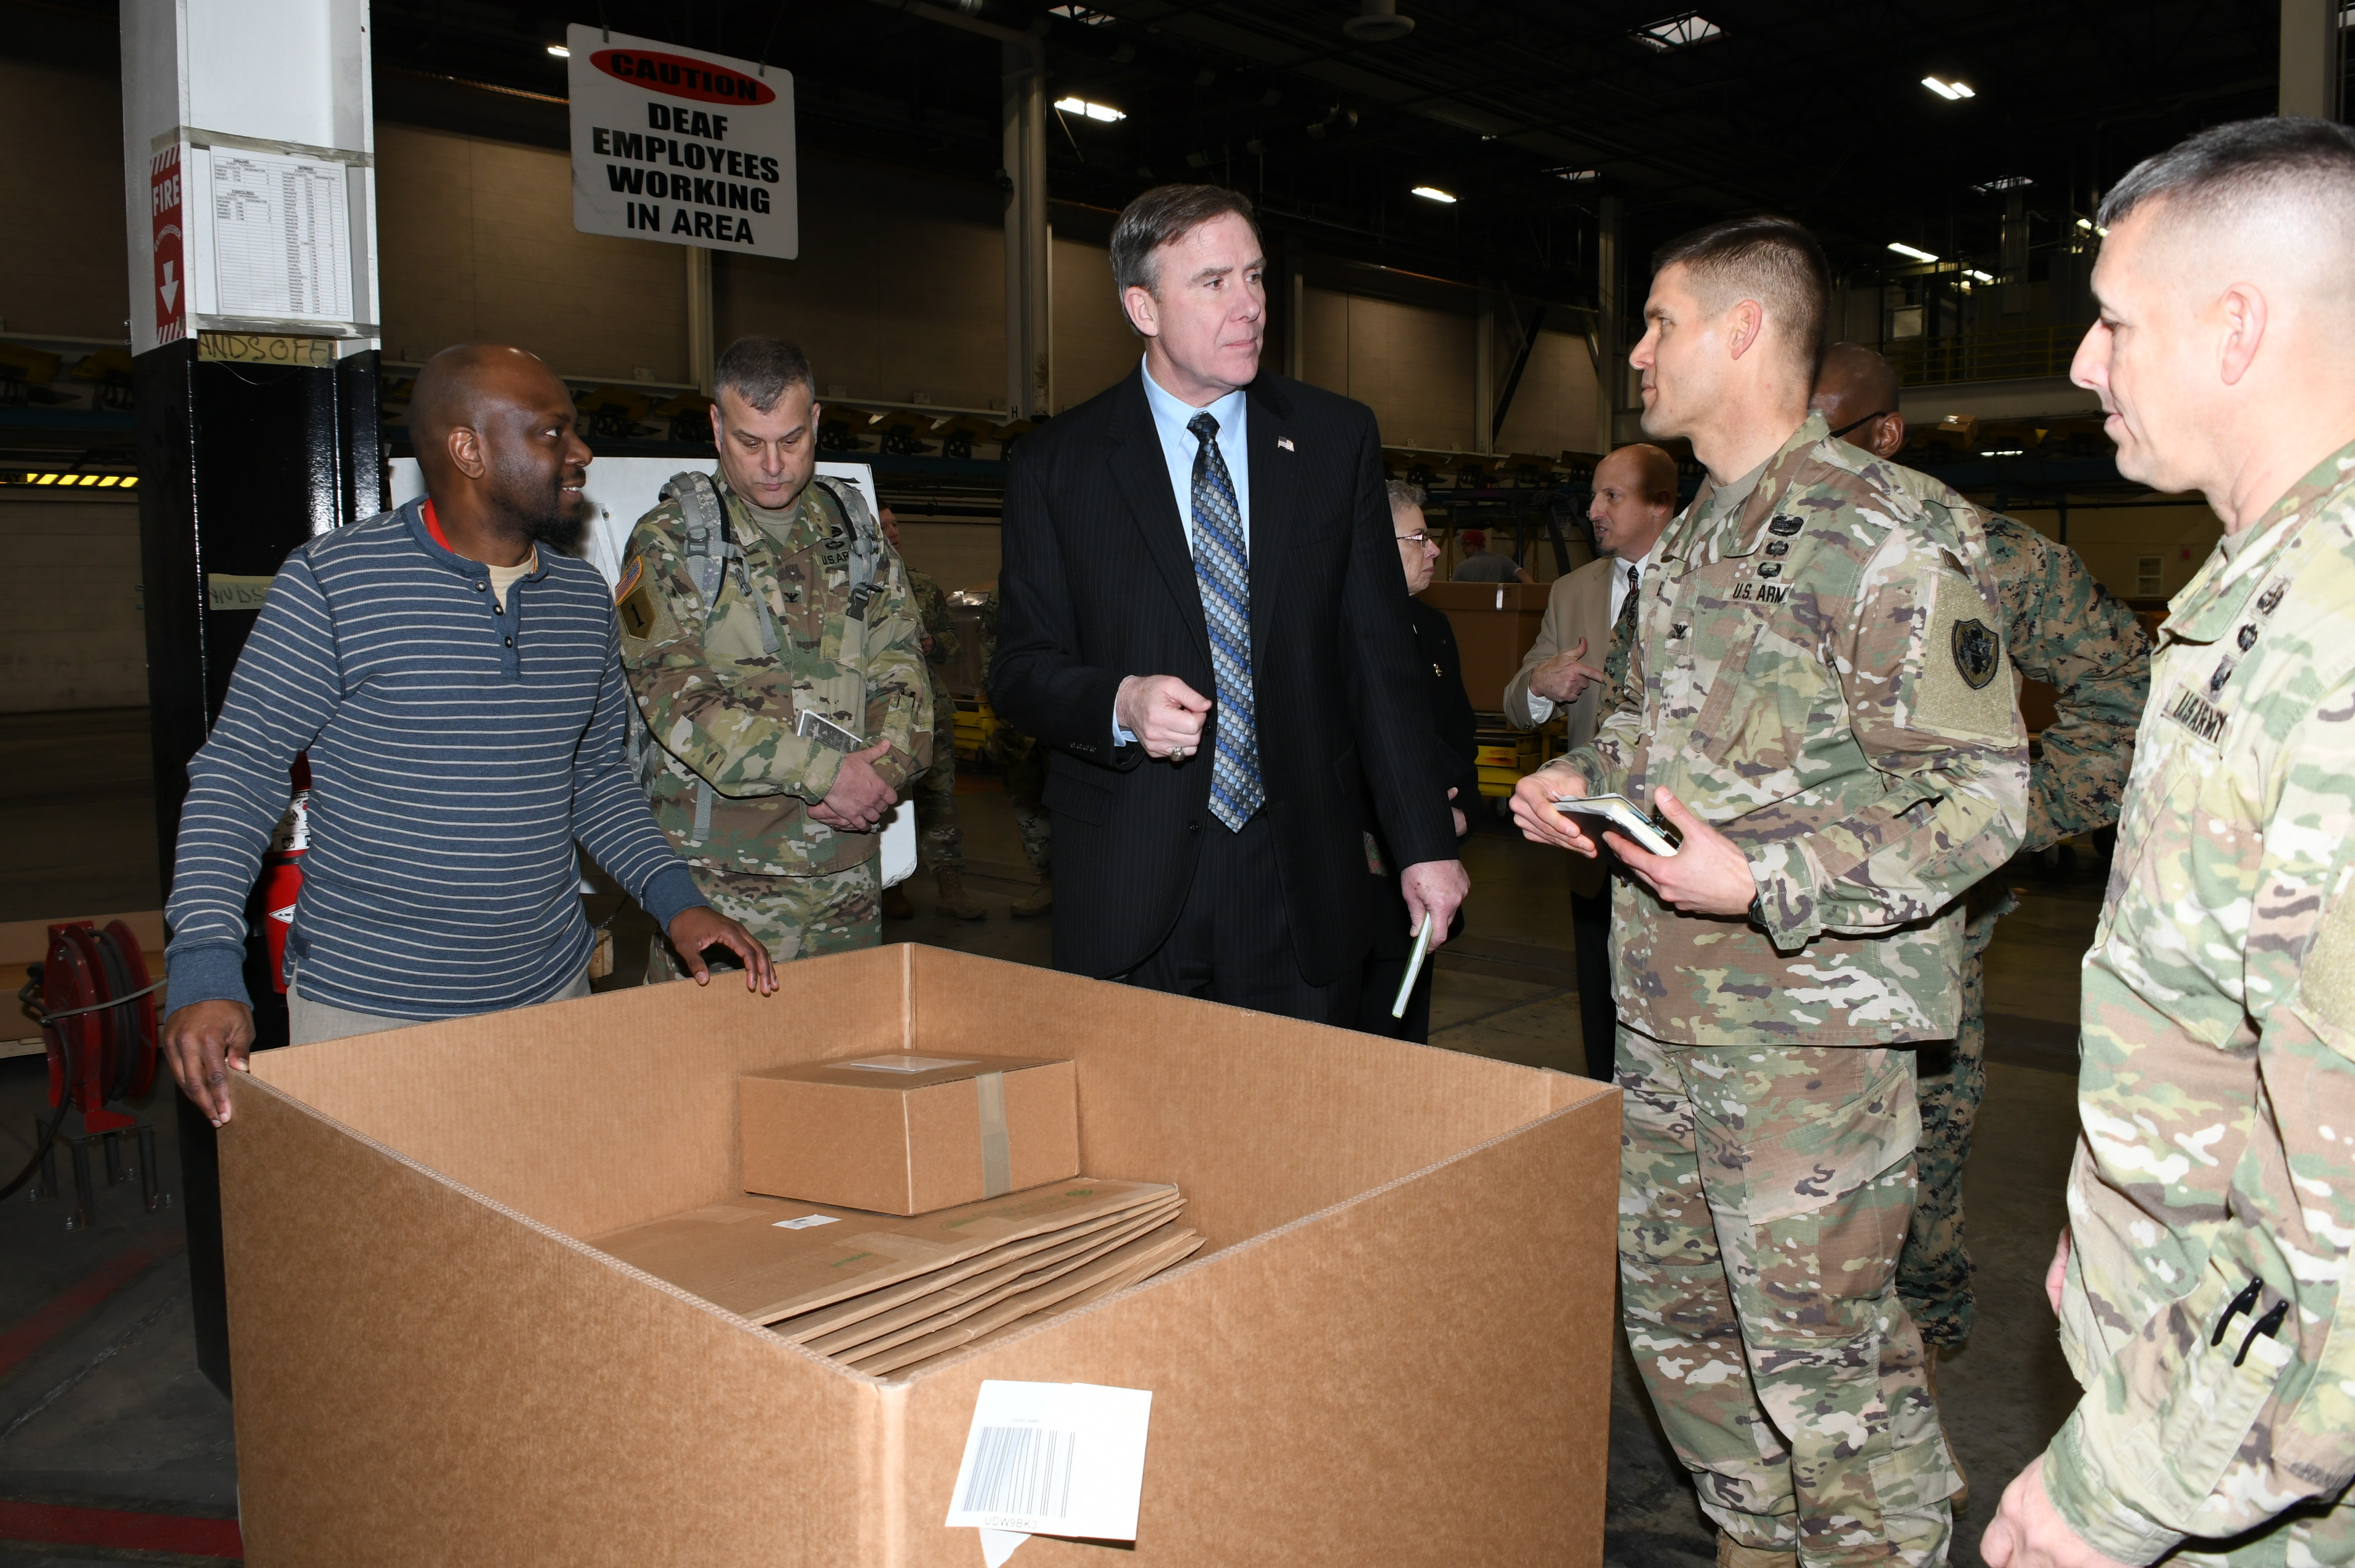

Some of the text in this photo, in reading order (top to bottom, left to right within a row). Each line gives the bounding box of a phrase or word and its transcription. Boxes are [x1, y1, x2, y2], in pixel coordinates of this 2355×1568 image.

[611, 54, 757, 102] CAUTION
[648, 102, 728, 141] DEAF
[592, 126, 780, 184] EMPLOYEES
[153, 174, 180, 217] FIRE
[606, 164, 770, 215] WORKING
[154, 224, 181, 252] EXTINGUISHER
[627, 201, 755, 245] IN AREA
[198, 333, 266, 362] ANDS
[1012, 405, 1018, 419] H
[837, 551, 849, 564] AR
[1756, 585, 1790, 603] ARM
[2187, 700, 2228, 743] ARMY
[984, 1515, 1038, 1529] UDW9BK3
